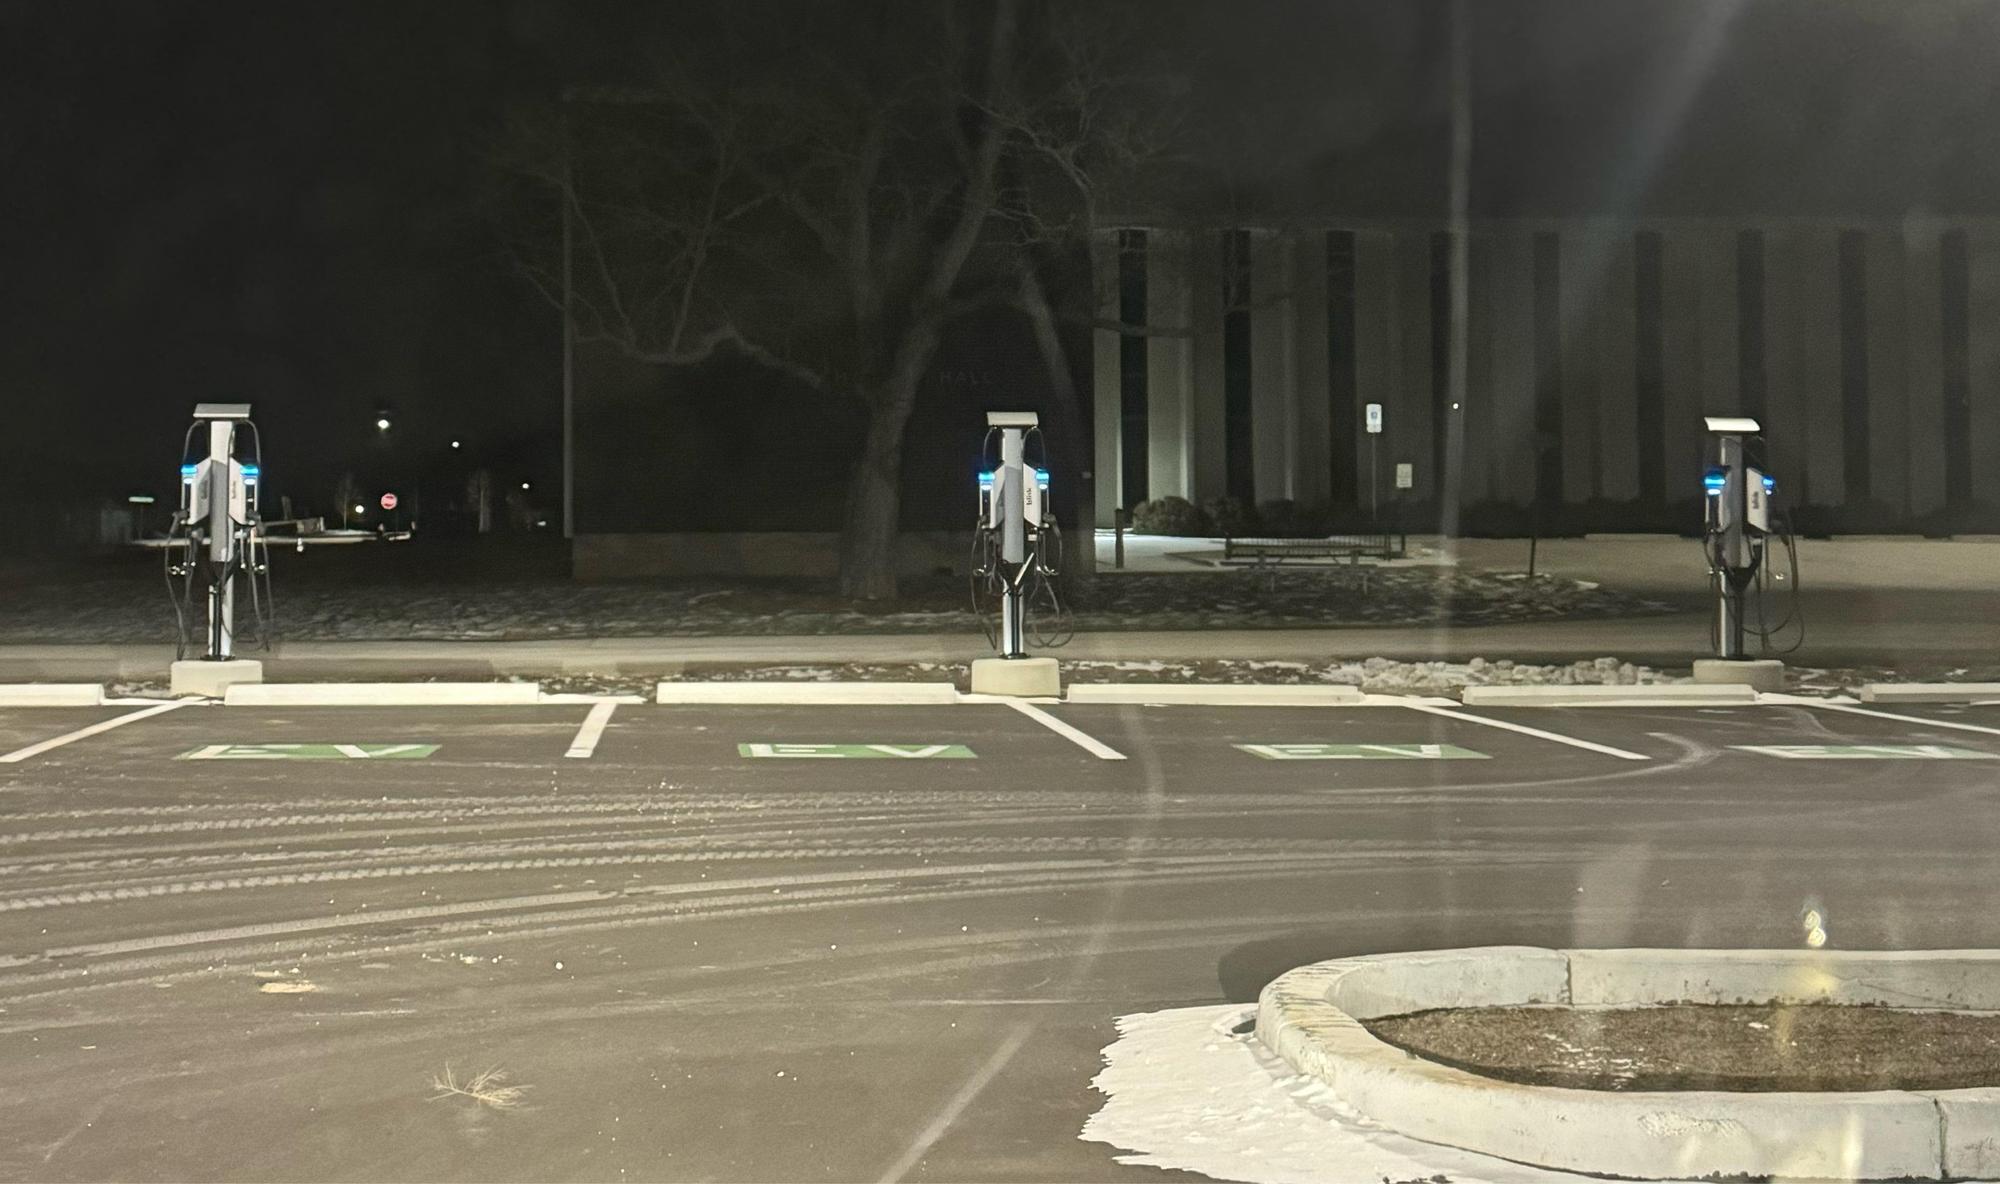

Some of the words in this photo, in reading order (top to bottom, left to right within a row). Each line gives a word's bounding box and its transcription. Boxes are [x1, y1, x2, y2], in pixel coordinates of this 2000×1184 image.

[939, 370, 992, 385] HALL
[188, 744, 426, 759] EV
[749, 744, 951, 758] EV
[1243, 744, 1442, 759] EV
